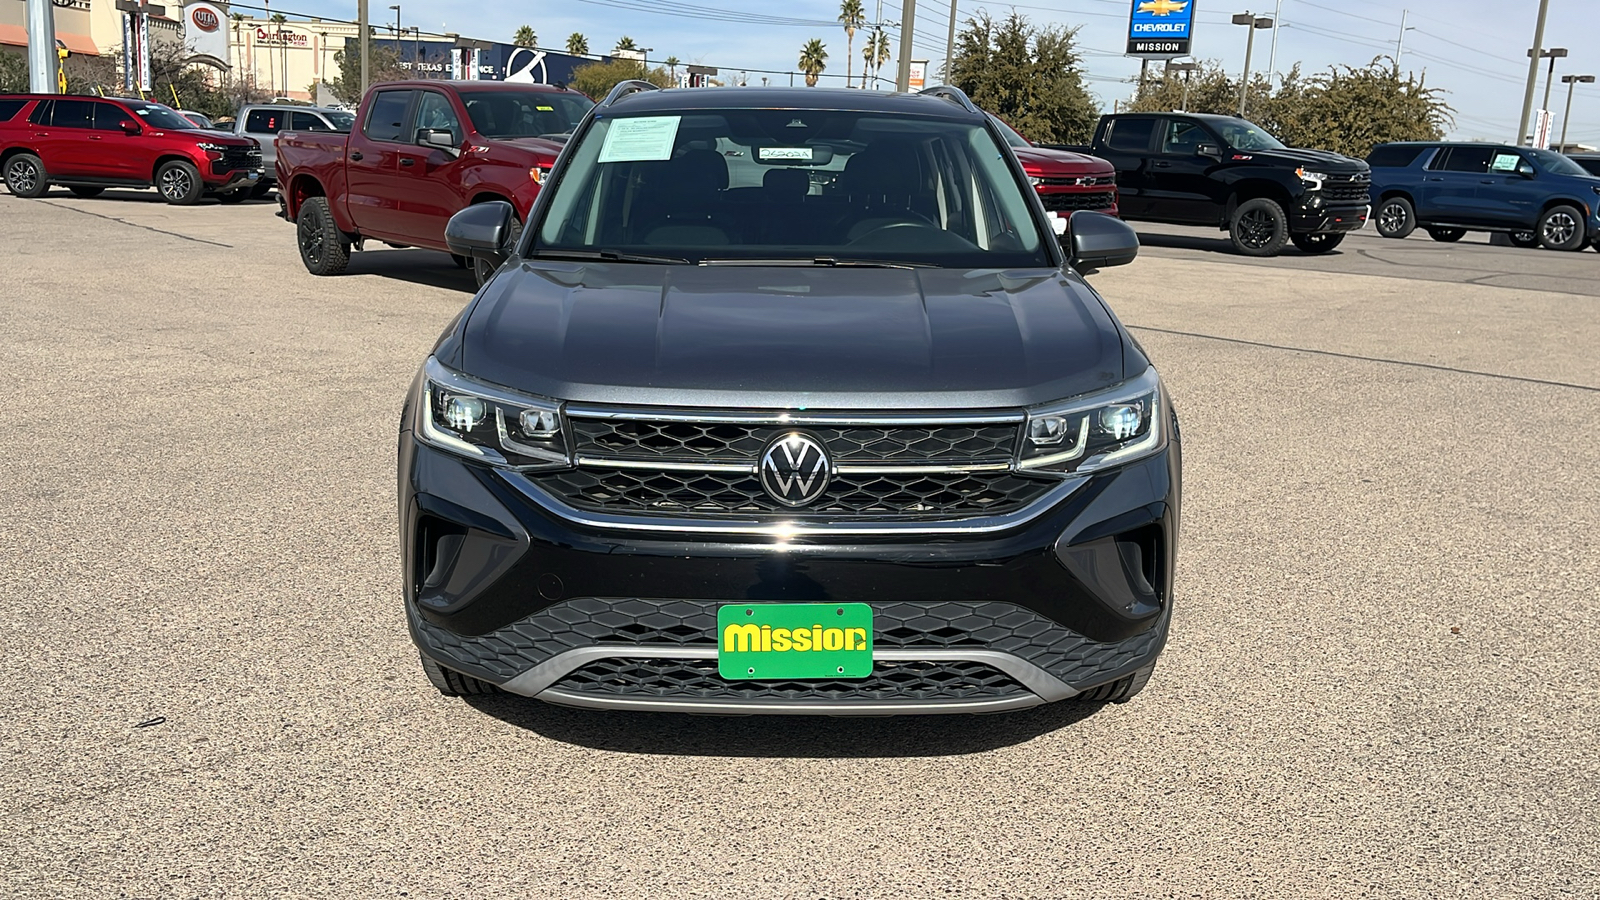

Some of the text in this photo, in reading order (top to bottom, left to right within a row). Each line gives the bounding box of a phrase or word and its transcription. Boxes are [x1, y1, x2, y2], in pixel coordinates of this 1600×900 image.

[1133, 23, 1187, 32] CHEVROLET
[1136, 42, 1179, 51] MISSION
[417, 63, 442, 72] TEXAS
[723, 622, 867, 653] Mission
